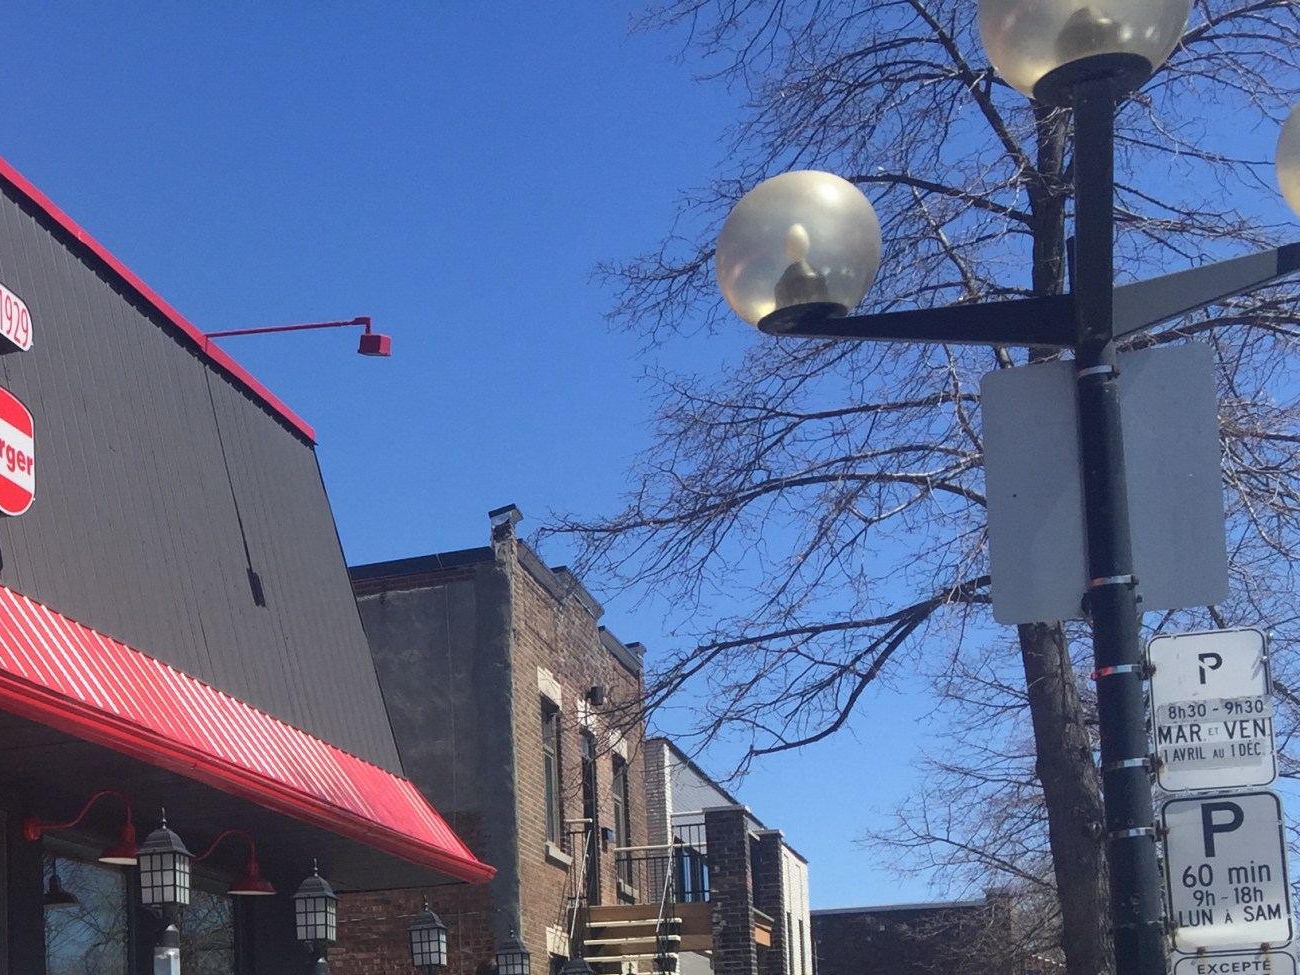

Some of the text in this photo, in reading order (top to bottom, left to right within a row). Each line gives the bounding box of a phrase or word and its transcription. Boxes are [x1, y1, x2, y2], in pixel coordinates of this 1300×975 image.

[1198, 652, 1223, 685] P
[1168, 703, 1207, 720] 8h30
[1224, 699, 1264, 716] 9h30
[1208, 727, 1219, 736] ET
[1173, 746, 1207, 762] AVRIL
[1212, 748, 1225, 759] AU
[1201, 801, 1245, 858] P
[1182, 860, 1272, 888] 60 min
[1193, 889, 1216, 907] 9h
[1234, 886, 1264, 905] 18h
[1179, 908, 1214, 929] LUN
[1243, 903, 1282, 923] SAM
[1197, 958, 1272, 975] EXCEPTÉ
